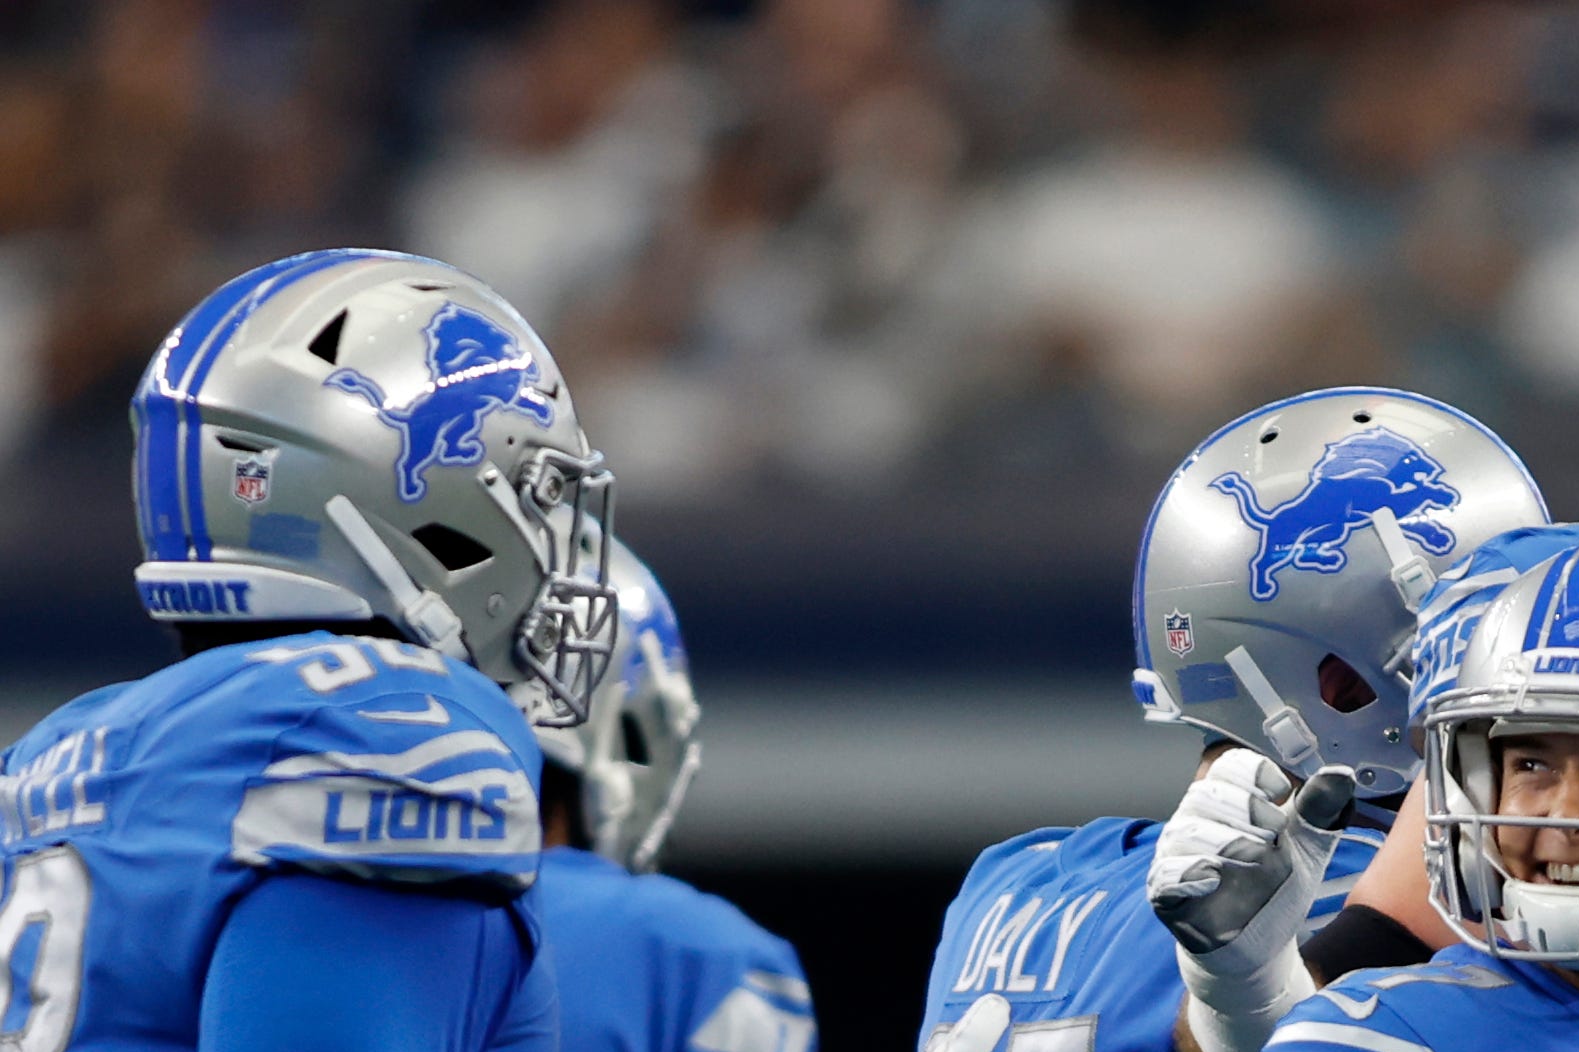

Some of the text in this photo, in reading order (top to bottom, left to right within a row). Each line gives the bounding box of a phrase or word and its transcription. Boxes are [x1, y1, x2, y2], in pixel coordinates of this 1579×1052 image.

[1168, 631, 1192, 649] NFL
[323, 783, 508, 844] LIONS
[952, 890, 1108, 994] DALY
